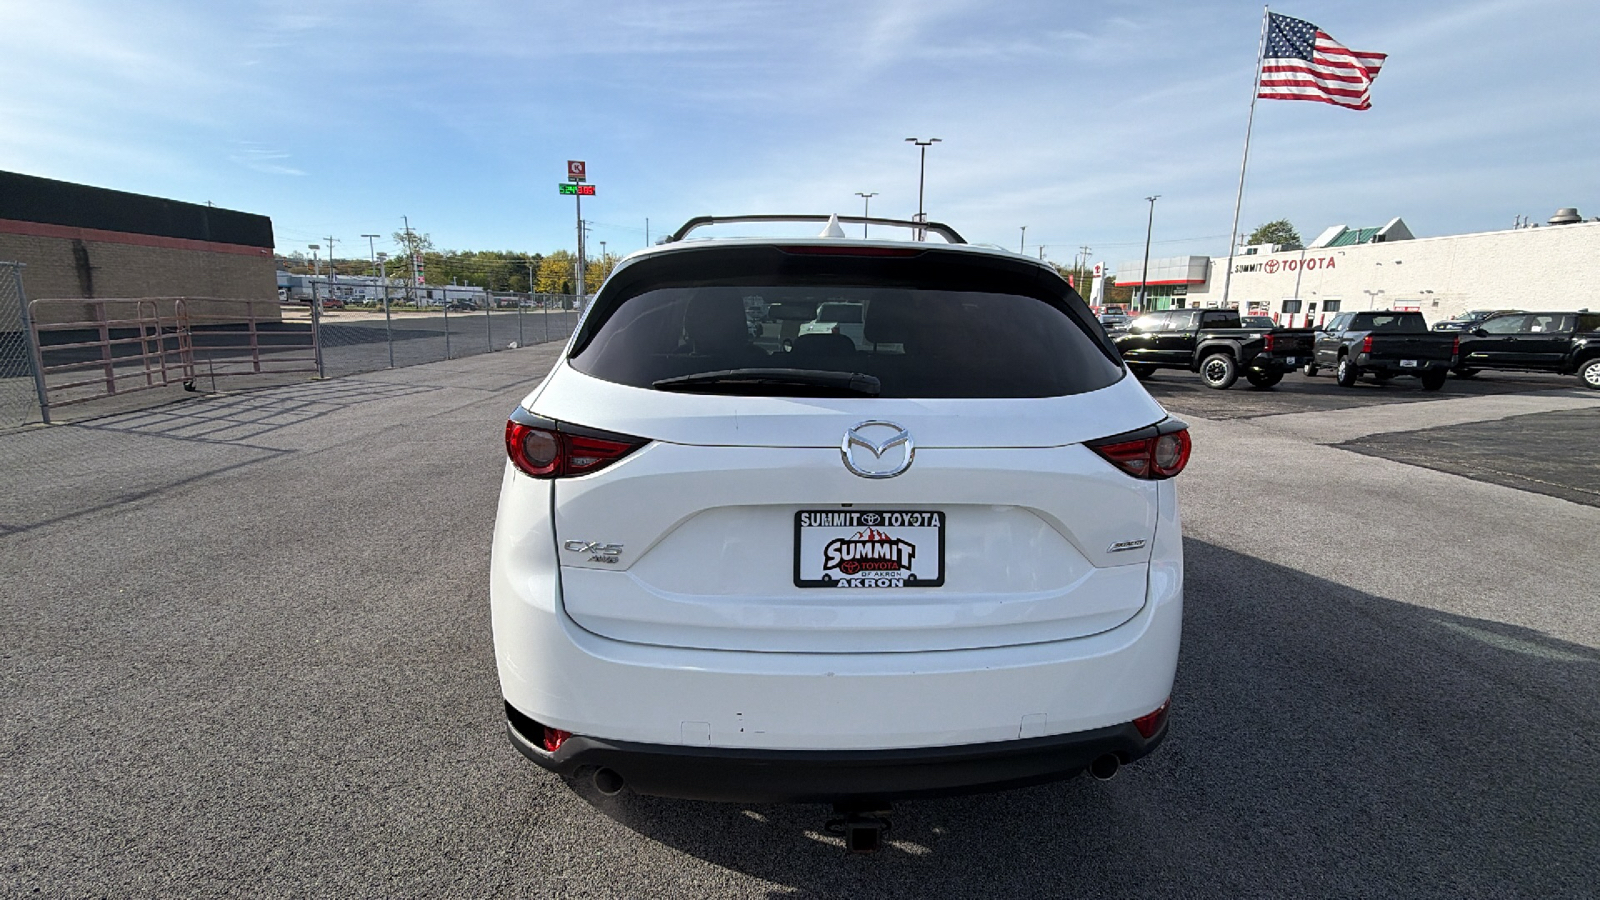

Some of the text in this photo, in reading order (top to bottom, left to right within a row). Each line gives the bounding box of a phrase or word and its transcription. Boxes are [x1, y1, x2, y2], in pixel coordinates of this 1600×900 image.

[1235, 257, 1335, 273] SUMMIT TOYOTA
[801, 513, 941, 527] SUMMIT TOYOTA
[564, 540, 624, 555] CX-5
[826, 540, 913, 569] SUMMIT
[861, 562, 899, 570] TOYOTA
[837, 579, 904, 588] AKRON
